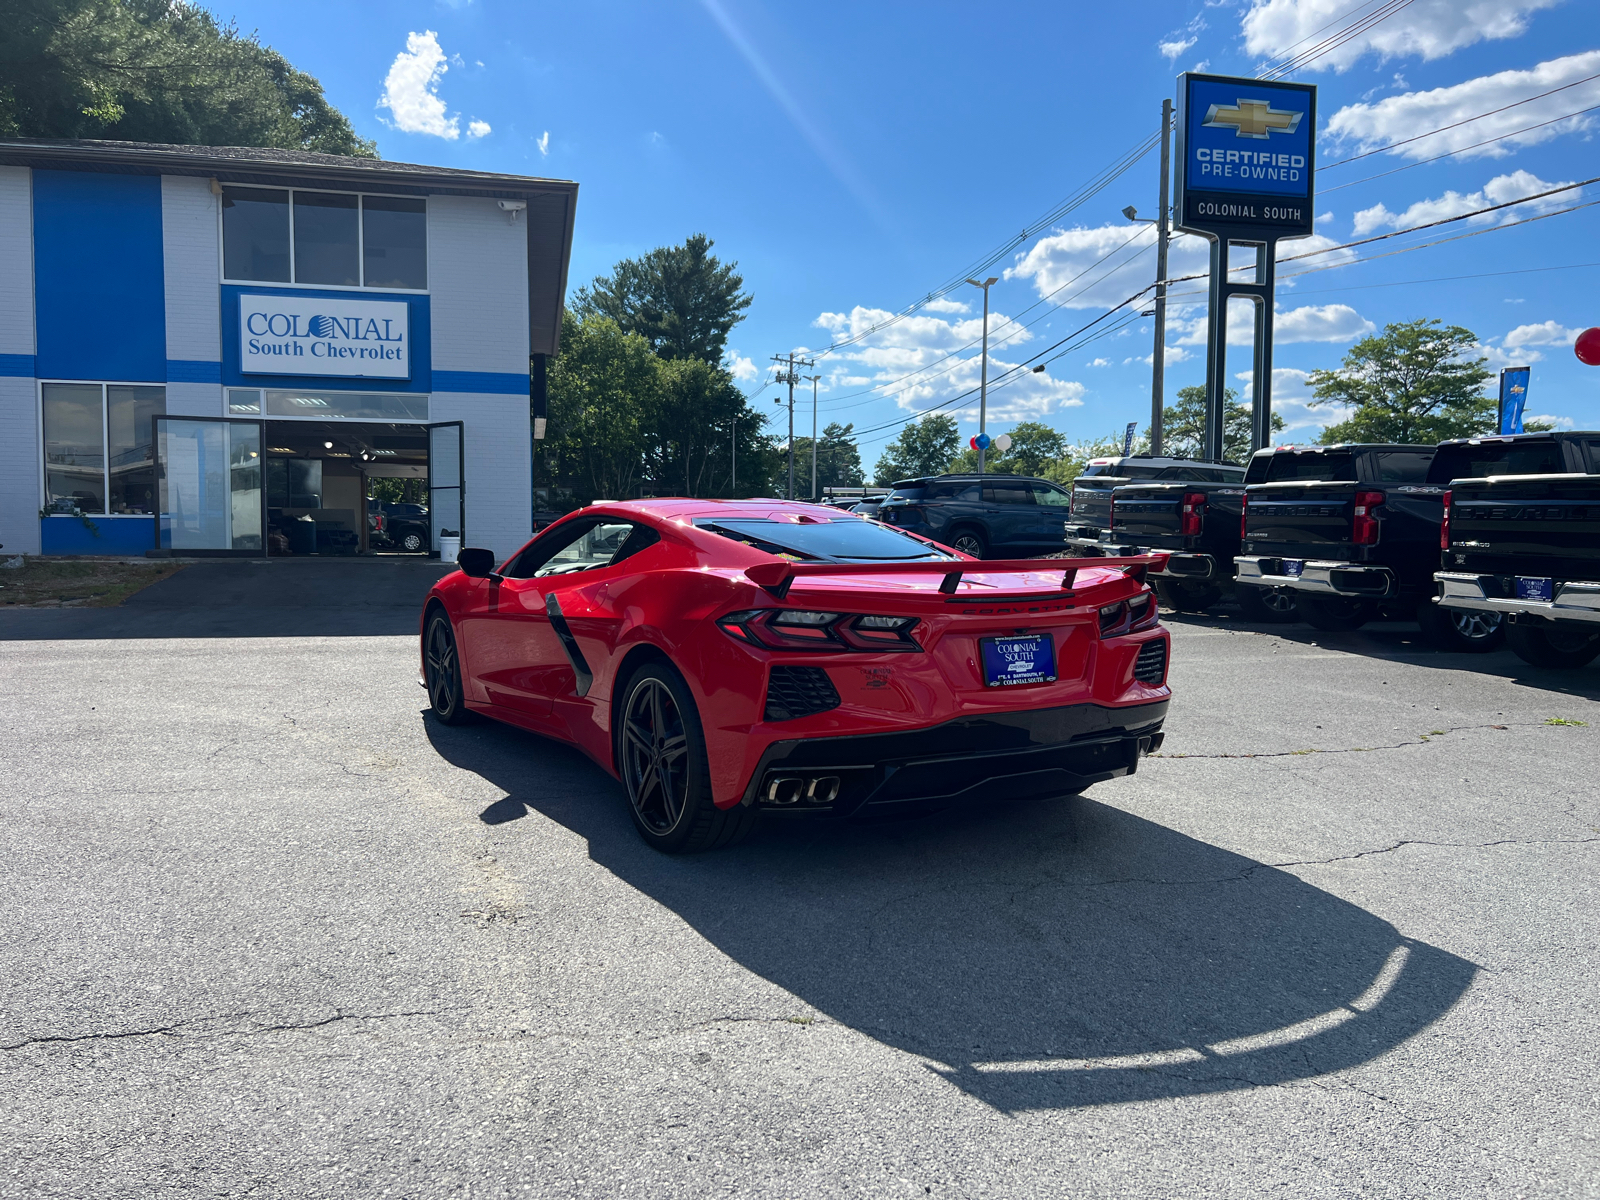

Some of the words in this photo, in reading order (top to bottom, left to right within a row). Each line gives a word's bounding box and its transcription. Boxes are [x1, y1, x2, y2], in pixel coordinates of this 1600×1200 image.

[1196, 148, 1305, 169] CERTIFIED
[1201, 163, 1300, 182] PRE-OWNED
[1198, 202, 1257, 218] COLONIAL
[1263, 206, 1301, 221] SOUTH
[246, 312, 403, 342] COLONIAL
[248, 338, 305, 356] South
[310, 341, 403, 360] Chevrolet
[962, 604, 1076, 614] CORVETTE
[997, 642, 1040, 654] COLONIAL
[1004, 651, 1034, 662] SOUTH
[1003, 678, 1028, 686] COLONIAL
